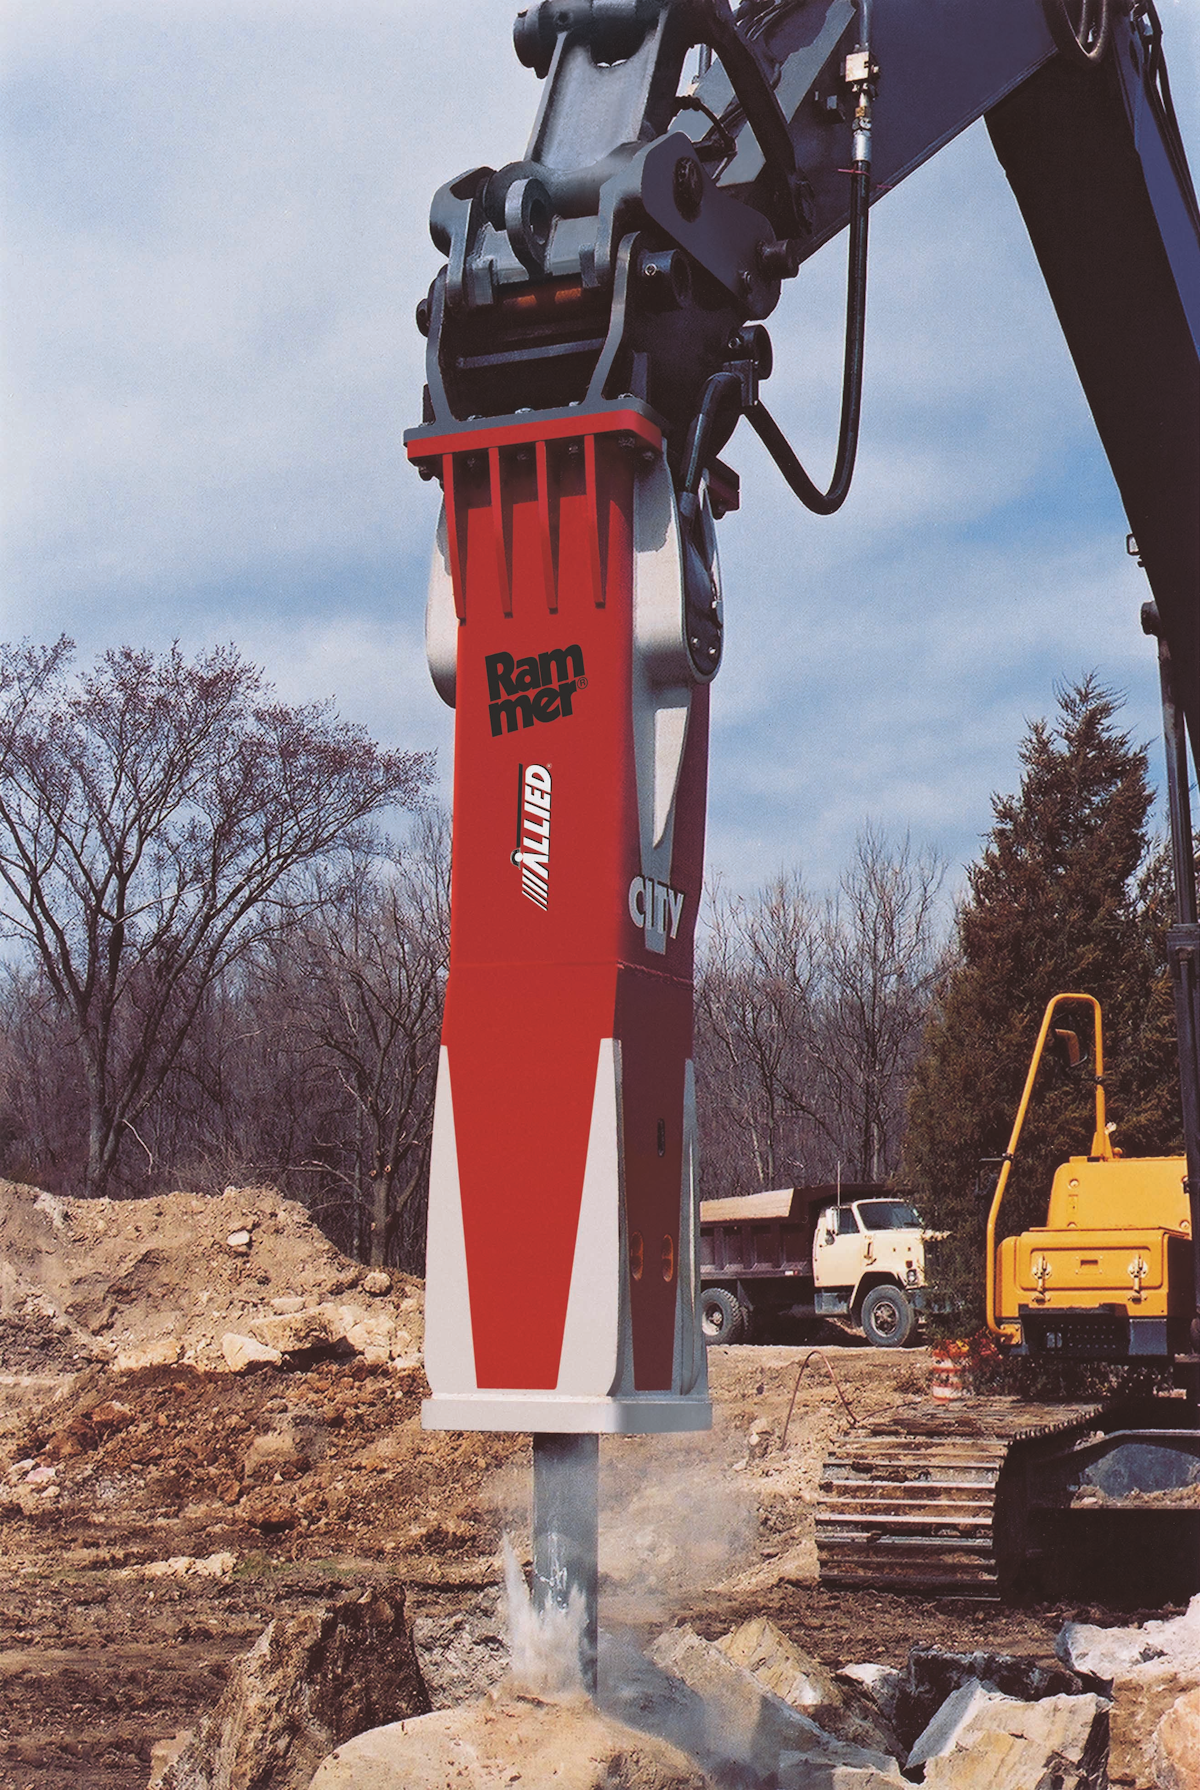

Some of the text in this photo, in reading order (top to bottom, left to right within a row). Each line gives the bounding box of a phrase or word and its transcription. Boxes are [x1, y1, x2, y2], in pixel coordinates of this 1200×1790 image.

[485, 644, 585, 702] Ram
[521, 763, 552, 881] ALLIED
[628, 875, 684, 939] CITY
